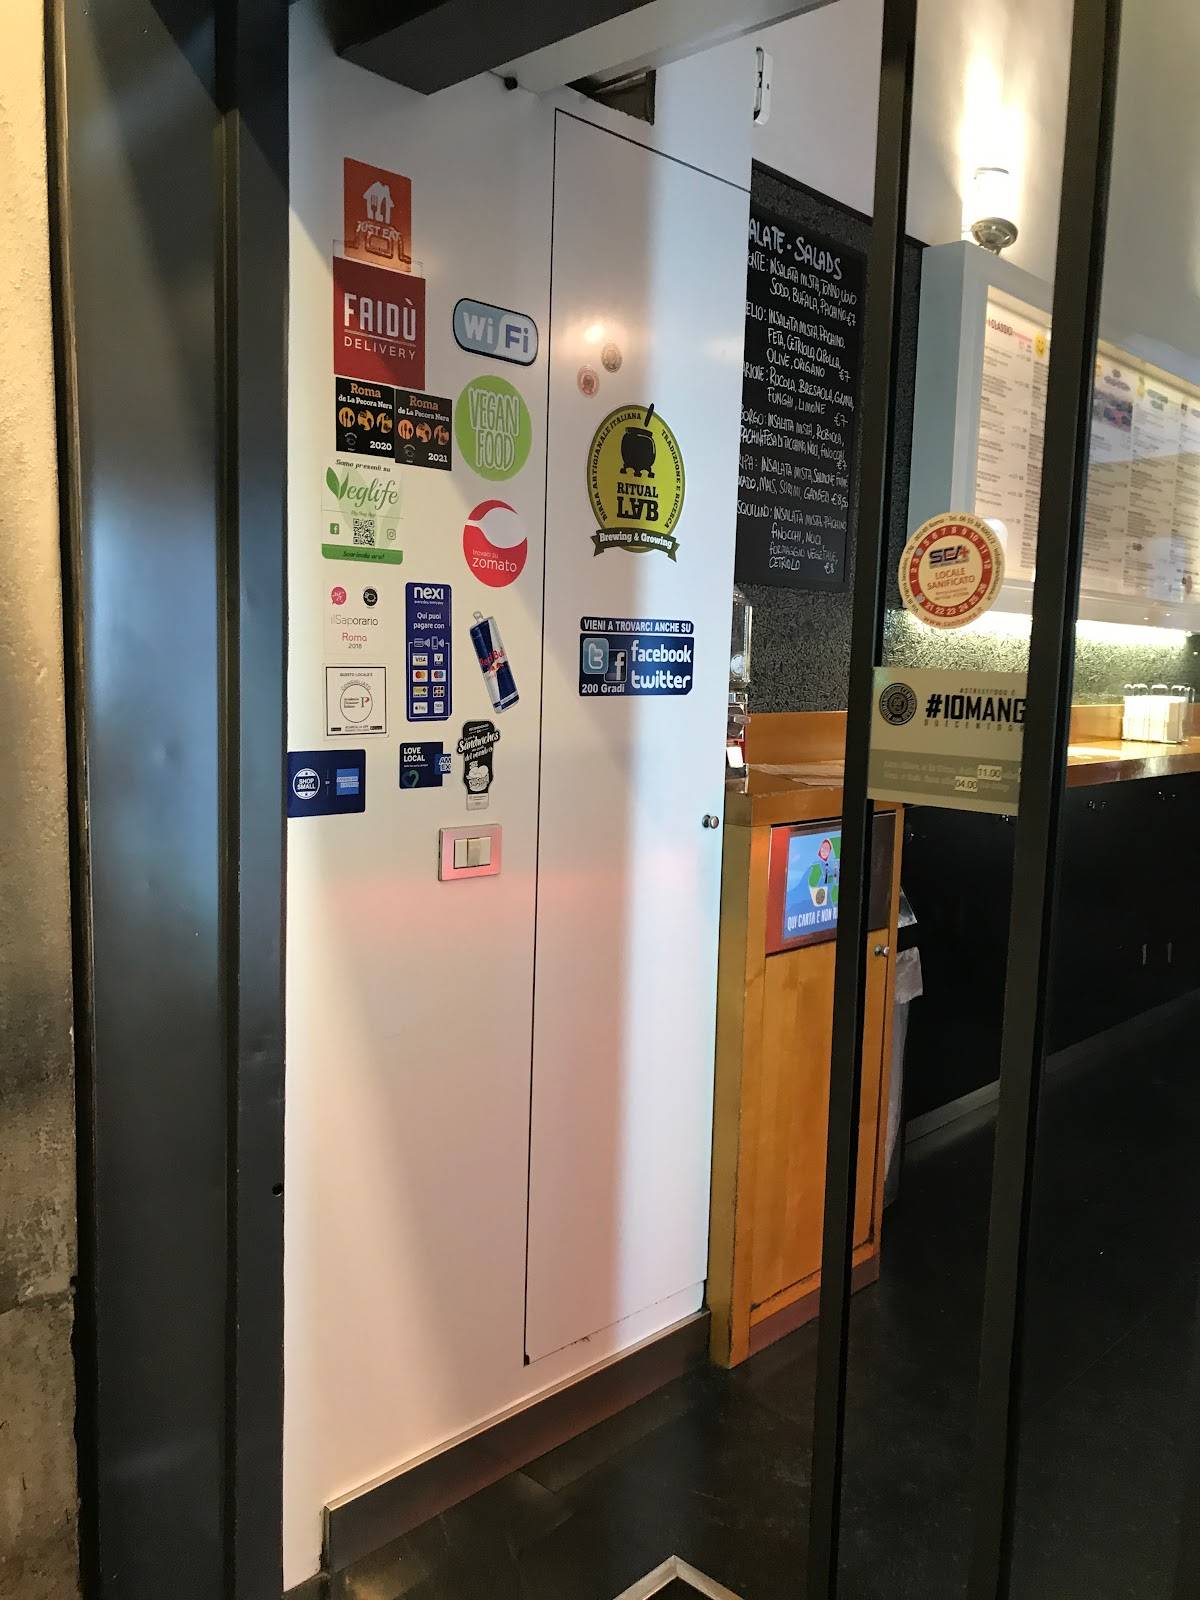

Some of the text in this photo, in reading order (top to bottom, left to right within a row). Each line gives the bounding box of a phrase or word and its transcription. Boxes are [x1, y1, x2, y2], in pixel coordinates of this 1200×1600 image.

[794, 236, 842, 280] SALADS
[770, 257, 799, 284] INSALATA
[792, 287, 820, 315] BUFALA,
[344, 292, 416, 342] FAIDÙ
[768, 308, 799, 333] INSALATA
[344, 336, 417, 360] DELIVERY
[793, 358, 825, 378] ORIGANO
[351, 383, 381, 398] Roma
[356, 398, 377, 407] Pecora
[377, 401, 393, 410] Nera
[409, 395, 439, 411] Roma
[406, 408, 414, 416] La
[414, 410, 435, 420] Pecora
[435, 414, 450, 422] Nera
[468, 388, 520, 437] VEGAN
[768, 412, 794, 432] INSALATA
[370, 441, 392, 451] 2020
[475, 428, 515, 471] FOOD
[592, 427, 611, 489] ARTIGIANALE
[610, 413, 642, 430] ITALIANA
[428, 453, 448, 463] 2021
[661, 429, 681, 484] TRADIZIONE
[761, 456, 792, 477] INSALATA
[326, 466, 399, 511] Veglife
[617, 481, 659, 498] RITUAL
[617, 496, 659, 522] LAB
[664, 492, 681, 528] RICERCA
[774, 506, 804, 524] INSALATA
[600, 531, 673, 549] Brewing & Growing
[472, 558, 517, 572] zomato
[935, 567, 966, 580] LOCALE
[927, 575, 976, 591] SANIFICATO
[413, 586, 444, 600] nexi
[417, 612, 441, 621] Qui puoi
[935, 607, 945, 615] 22
[946, 607, 956, 615] 23
[413, 622, 433, 630] pagare
[584, 619, 691, 633] VIENI A TROVARCI ANCHE SU
[342, 632, 368, 641] Roma
[631, 639, 692, 663] facebook
[581, 683, 625, 693] 200 Gradi
[631, 670, 691, 689] twitter
[798, 912, 816, 927] CARTA
[816, 910, 821, 923] E
[821, 908, 833, 922] NON
